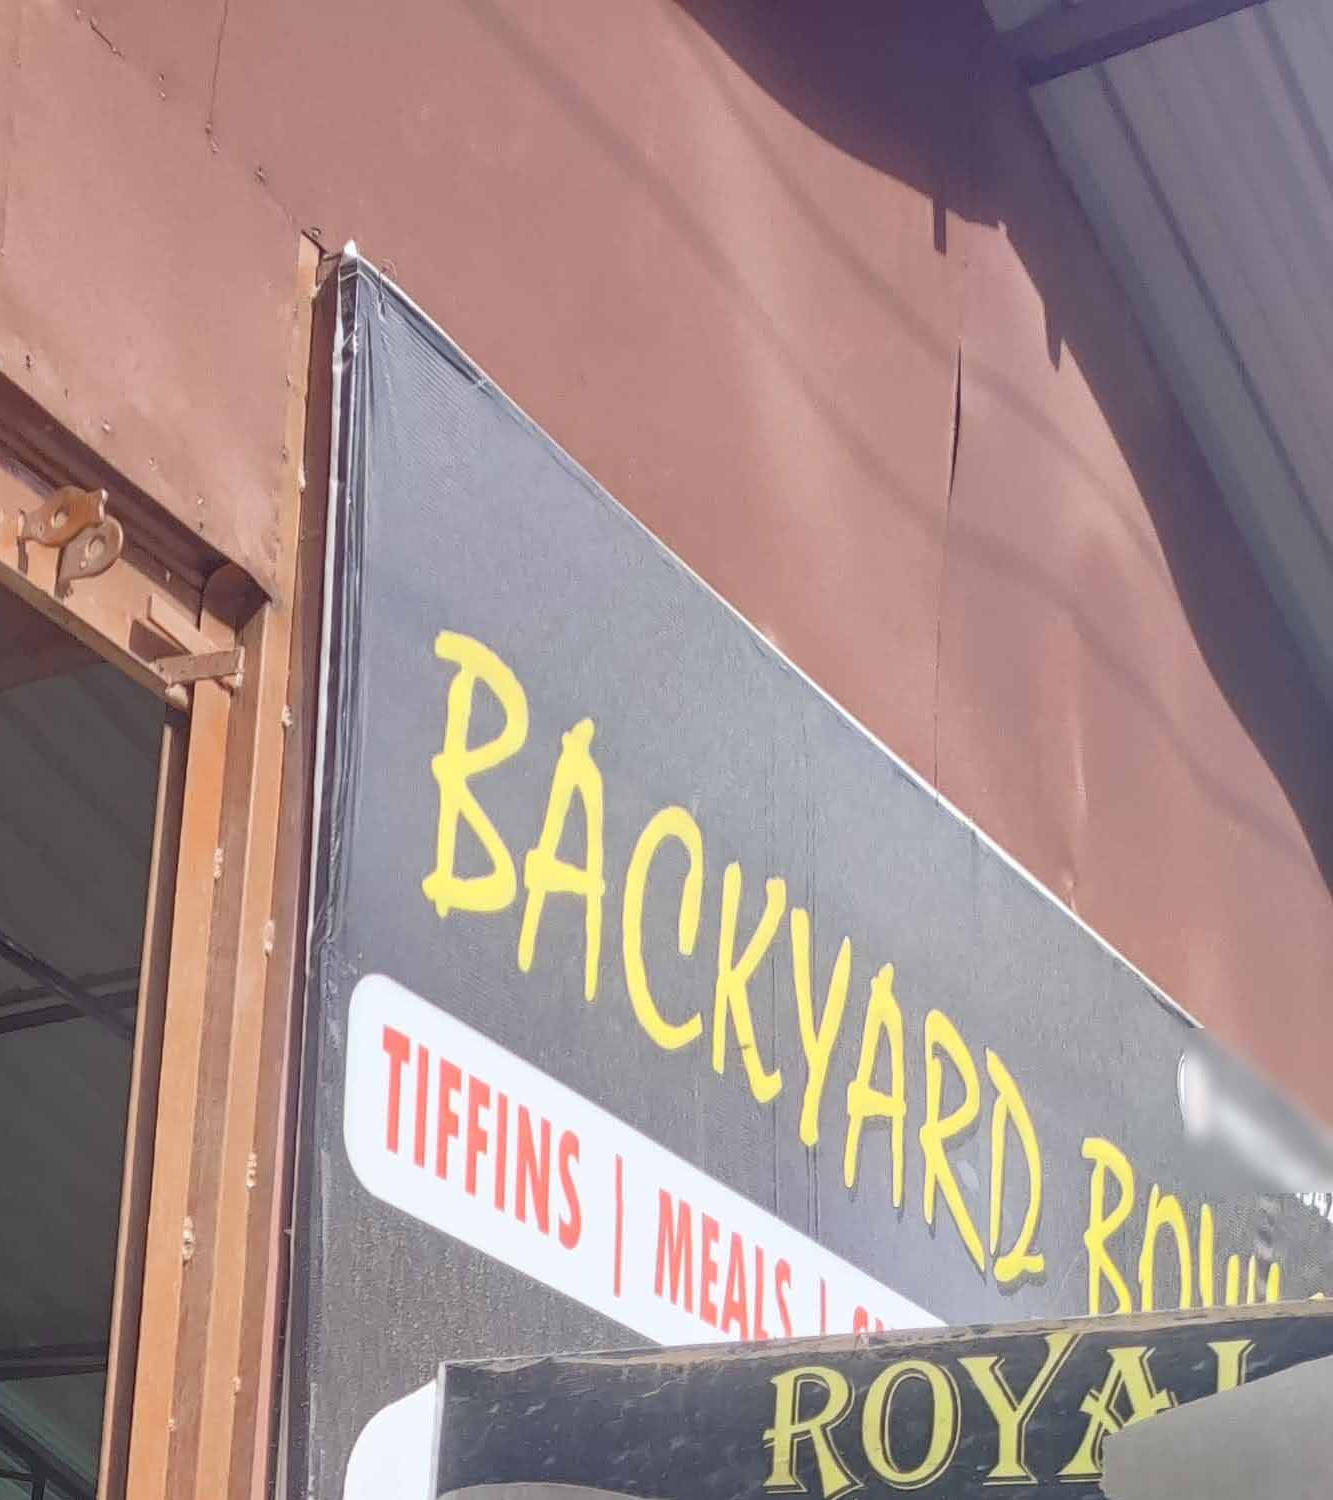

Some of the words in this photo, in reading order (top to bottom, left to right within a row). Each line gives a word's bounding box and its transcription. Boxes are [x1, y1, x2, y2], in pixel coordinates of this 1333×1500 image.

[381, 1025, 582, 1249] TIFFINS
[653, 1186, 794, 1345] MEALS
[422, 629, 1044, 1283] BACKYARD
